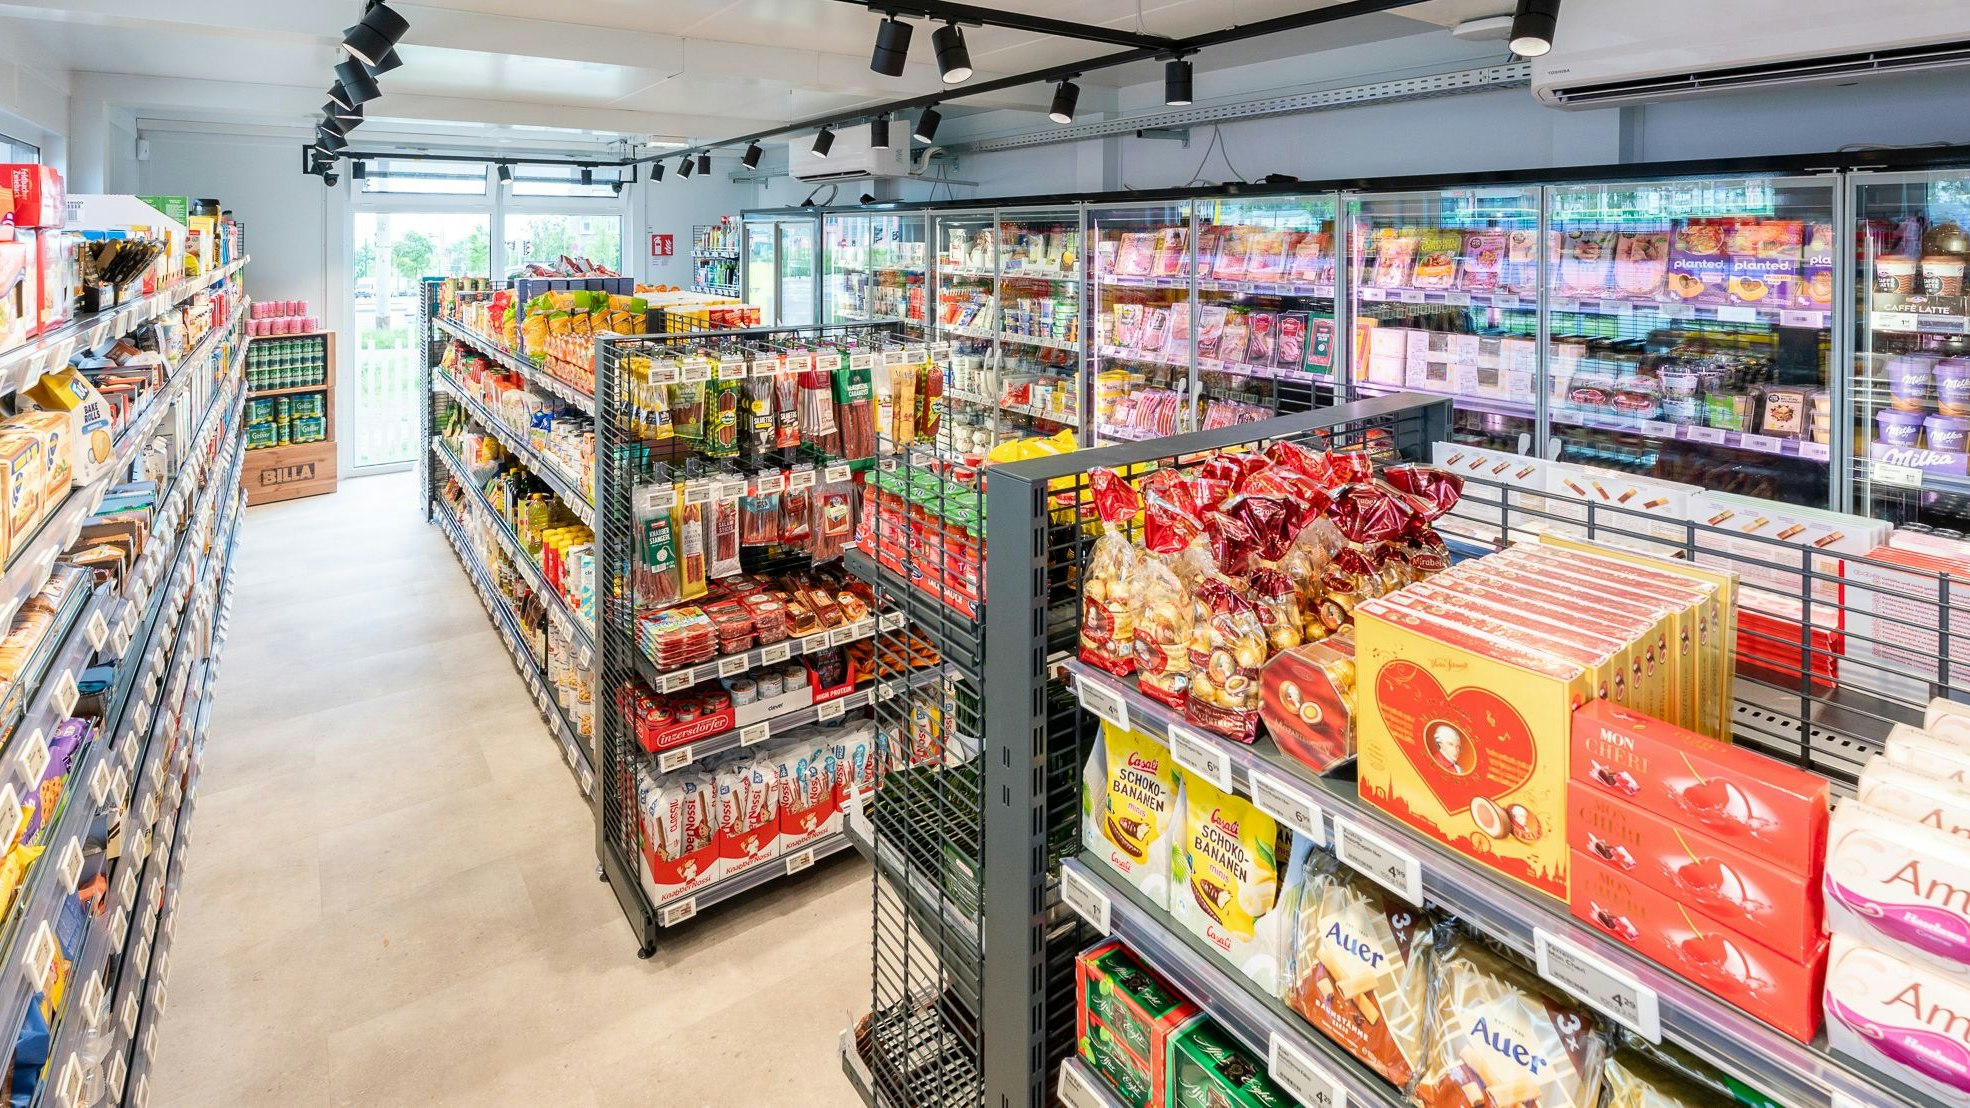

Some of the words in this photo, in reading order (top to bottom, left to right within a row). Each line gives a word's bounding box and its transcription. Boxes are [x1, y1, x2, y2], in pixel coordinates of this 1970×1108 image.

[1674, 259, 1726, 270] planted.
[1735, 261, 1792, 271] planted.
[1884, 303, 1917, 312] CAFFÈ
[1919, 306, 1950, 314] LATTE
[84, 402, 99, 414] BAKE
[84, 410, 101, 424] ROLLS
[1886, 424, 1916, 438] Milka
[1930, 431, 1963, 444] Milka
[1881, 448, 1956, 467] Milka
[262, 464, 313, 486] BILLA
[816, 690, 829, 701] HIGH
[830, 686, 852, 698] PROTEIN
[767, 702, 784, 712] clever
[659, 718, 726, 747] inzersdorfer
[1599, 727, 1635, 750] MON
[1127, 751, 1158, 773] Casali
[1585, 738, 1648, 774] CHERI
[1120, 768, 1167, 796] SCHOKO-
[1112, 779, 1164, 813] BANANEN
[1128, 802, 1146, 818] minis
[1210, 808, 1239, 836] Casali
[1202, 825, 1250, 863] SCHOKO-
[725, 850, 772, 875] KnabberNossi
[1111, 851, 1131, 872] Casali
[1194, 836, 1248, 883] BANANEN
[1209, 863, 1230, 884] minis
[661, 875, 711, 902] KnabberNossi
[1206, 925, 1232, 950] Casali
[1326, 921, 1384, 969] Auer
[1137, 986, 1162, 1008] Eight
[1123, 1022, 1146, 1050] Eight
[1470, 1016, 1547, 1076] Auer
[1121, 1074, 1142, 1099] Eight
